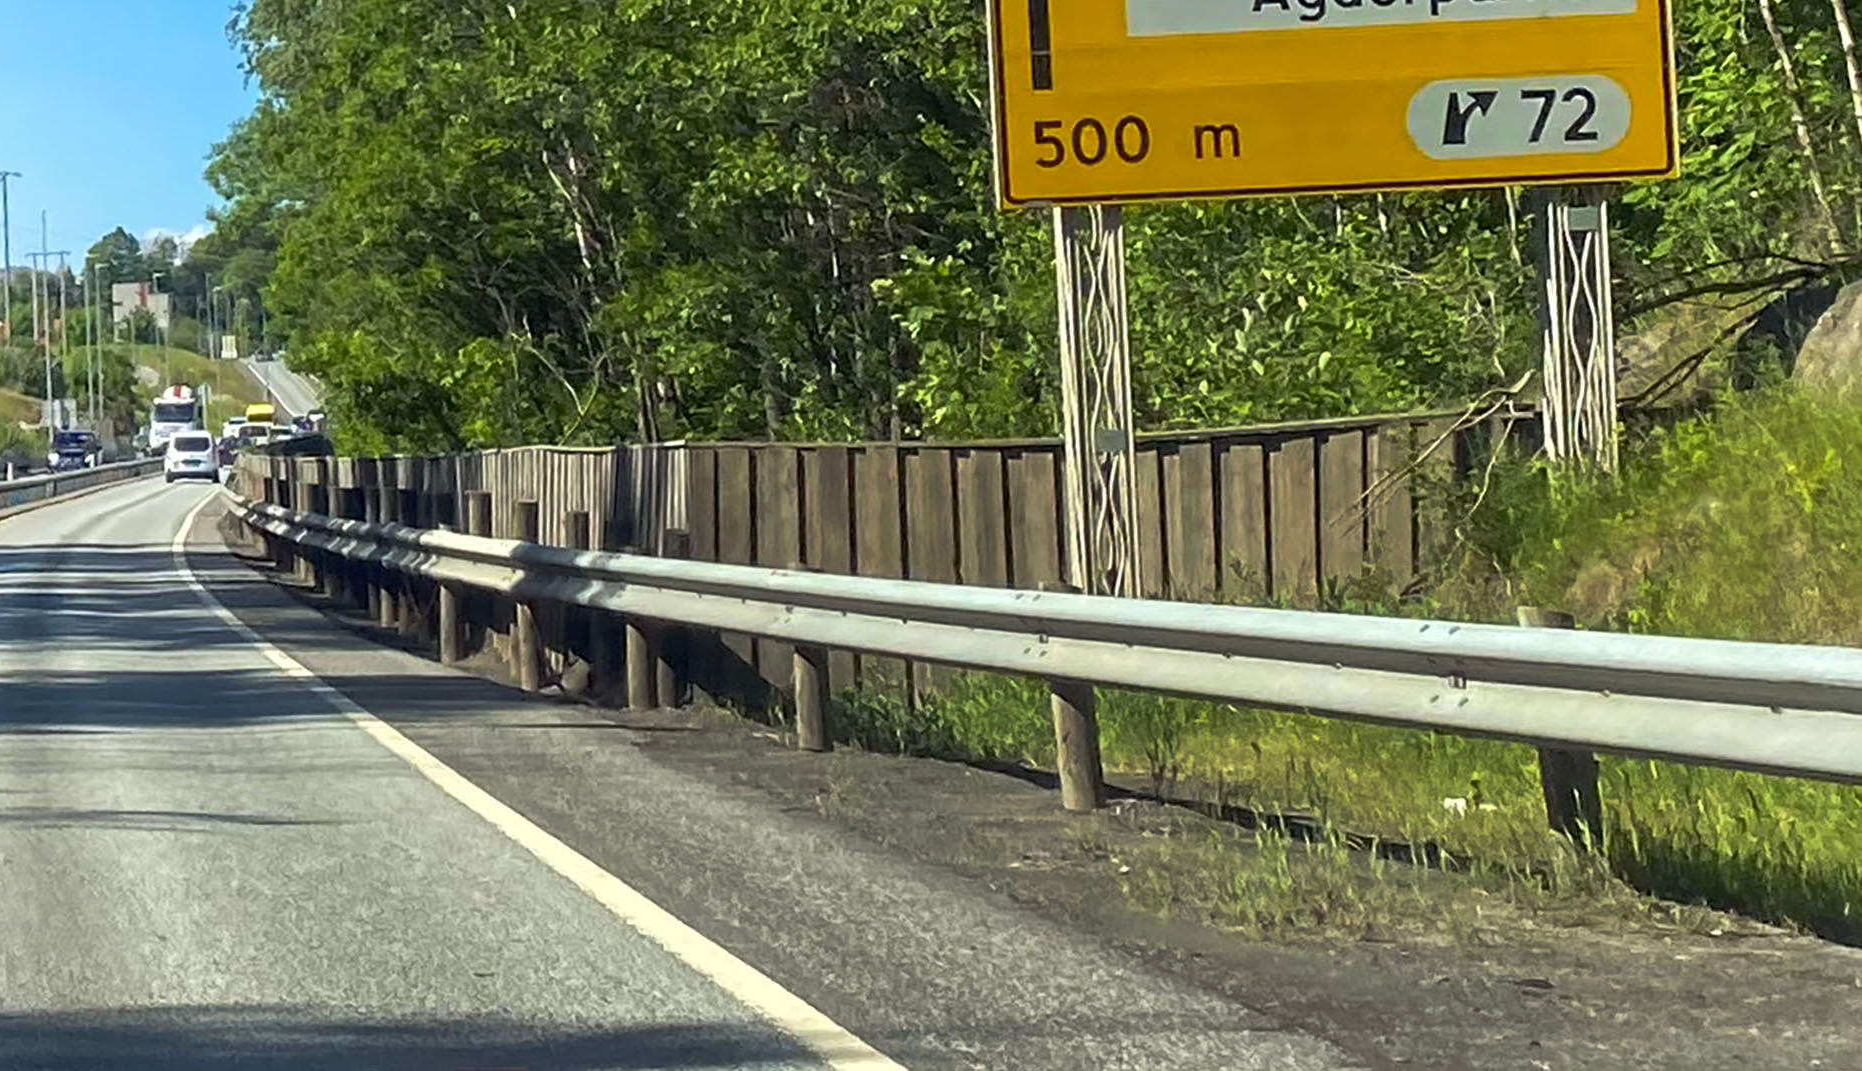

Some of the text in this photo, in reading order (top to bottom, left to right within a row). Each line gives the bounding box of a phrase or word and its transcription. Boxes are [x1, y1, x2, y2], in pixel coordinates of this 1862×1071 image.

[1033, 115, 1241, 169] 500 m
[1520, 87, 1599, 143] 72
